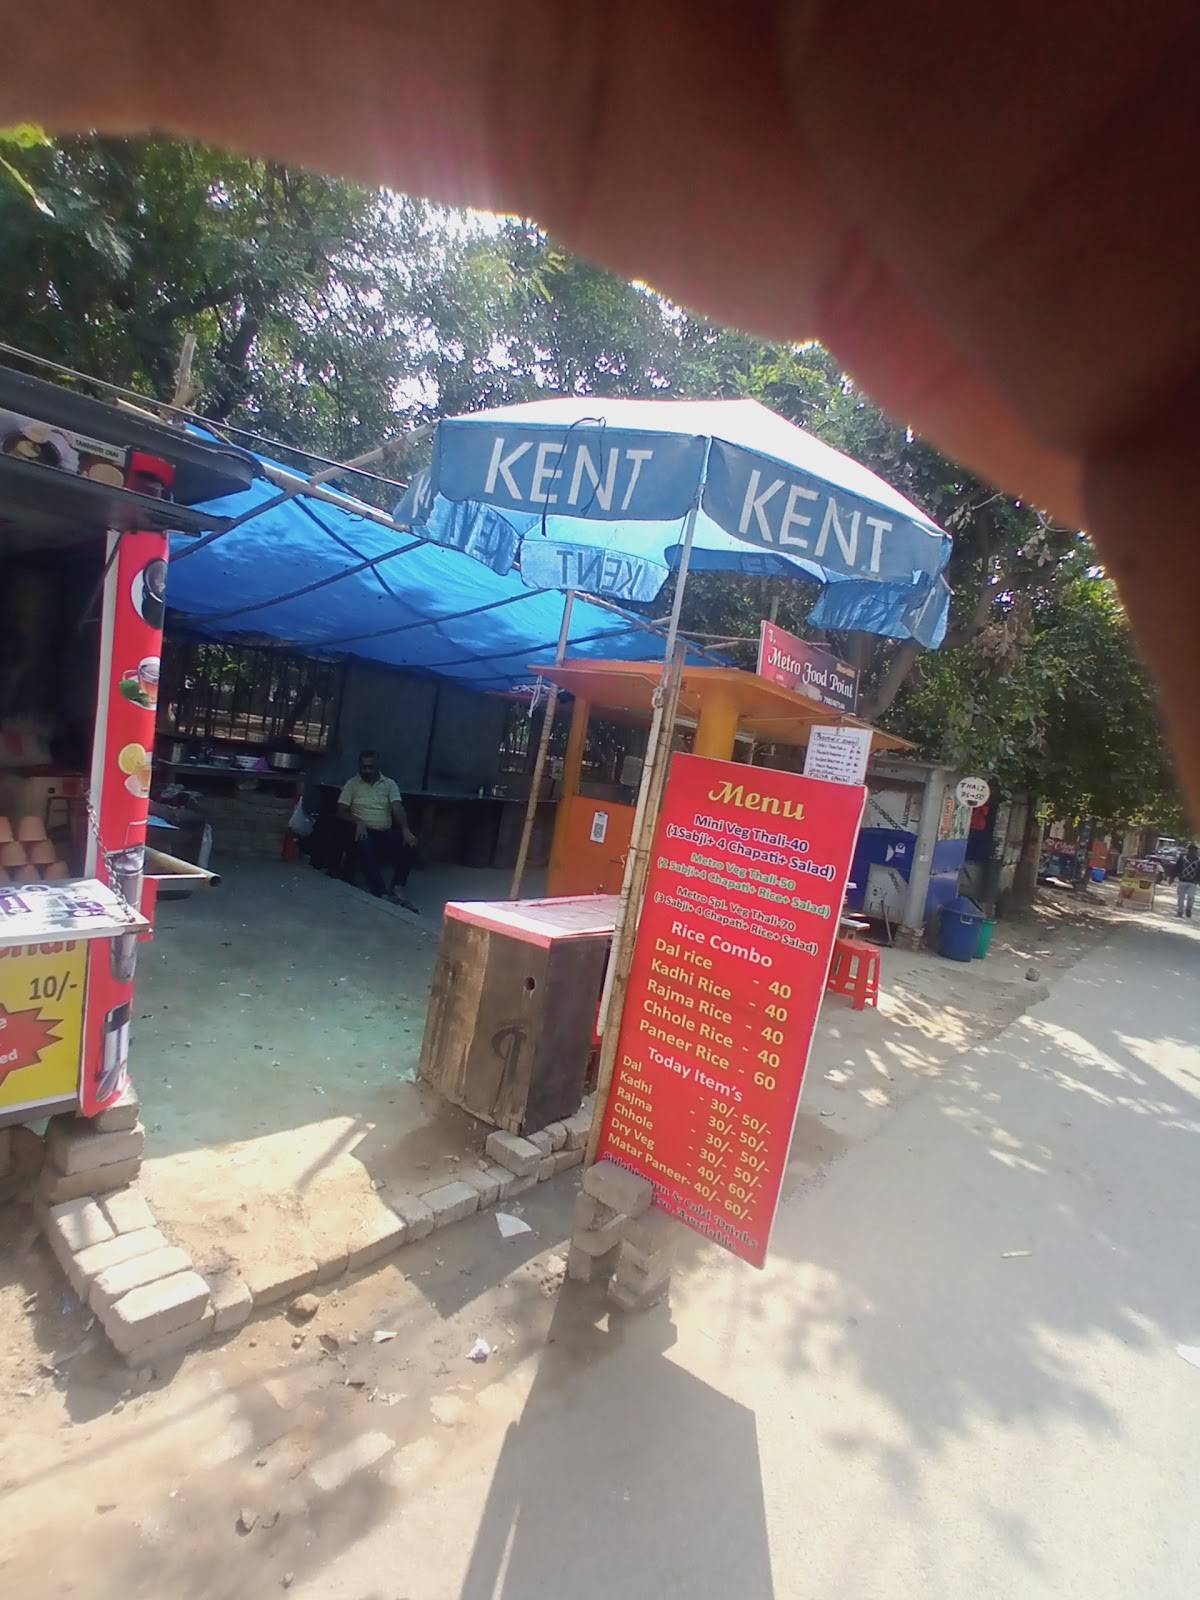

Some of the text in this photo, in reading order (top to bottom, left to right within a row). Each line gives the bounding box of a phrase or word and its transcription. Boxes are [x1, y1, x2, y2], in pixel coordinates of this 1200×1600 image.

[484, 438, 653, 511] KENT
[739, 470, 892, 572] KENT
[768, 647, 801, 676] Metro
[802, 662, 827, 687] Food
[830, 674, 854, 698] Point
[708, 781, 805, 820] Menu
[694, 814, 808, 852] Mini Veg Thali-40
[717, 839, 725, 849] 4
[728, 841, 788, 864] Chapati+
[789, 858, 836, 881] Salad)
[677, 886, 707, 903] Metro
[730, 903, 750, 918] Veg
[691, 853, 796, 890] Metro Veg Thali-50
[704, 909, 749, 930] Chapati+
[750, 925, 780, 940] Rice+
[782, 935, 818, 956] Salad)
[758, 888, 790, 904] Rice+
[792, 897, 831, 919] Salad)
[656, 938, 680, 958] Dal
[684, 950, 712, 970] rice
[768, 982, 792, 999] 40
[672, 920, 772, 968] Rice Combo
[28, 971, 78, 1001] 10/-
[647, 978, 694, 1008] Rajma
[698, 1000, 732, 1024] Rice
[761, 1027, 784, 1045] 40
[651, 958, 694, 986] Kadhi
[698, 976, 732, 1000] Rice
[764, 1004, 788, 1022] 40
[640, 1019, 692, 1052] Paneer
[696, 1044, 729, 1070] Rice
[754, 1072, 776, 1090] 60
[644, 1000, 696, 1031] Chhole
[700, 1023, 733, 1048] Rice
[757, 1050, 780, 1068] 40
[622, 1056, 642, 1072] Dal
[710, 1098, 738, 1118] 30/-
[741, 1114, 772, 1134] 50/-
[648, 1046, 743, 1102] Today Item's
[617, 1087, 652, 1112] Rajma
[705, 1132, 734, 1152] 30/-
[740, 1151, 770, 1172] 50/-
[620, 1071, 653, 1095] Kadhi
[708, 1116, 736, 1135] 30/-
[739, 1132, 768, 1152] 50/-
[611, 1118, 632, 1136] Dry
[634, 1129, 655, 1150] Veg
[697, 1166, 725, 1186] 40/-
[728, 1183, 757, 1204] 60/-
[614, 1102, 654, 1130] Chhole
[698, 1148, 727, 1168] 30/-
[734, 1166, 762, 1188] 50/-
[608, 1132, 642, 1158] Matar
[694, 1182, 721, 1202] 40/-
[724, 1200, 753, 1221] 60/-
